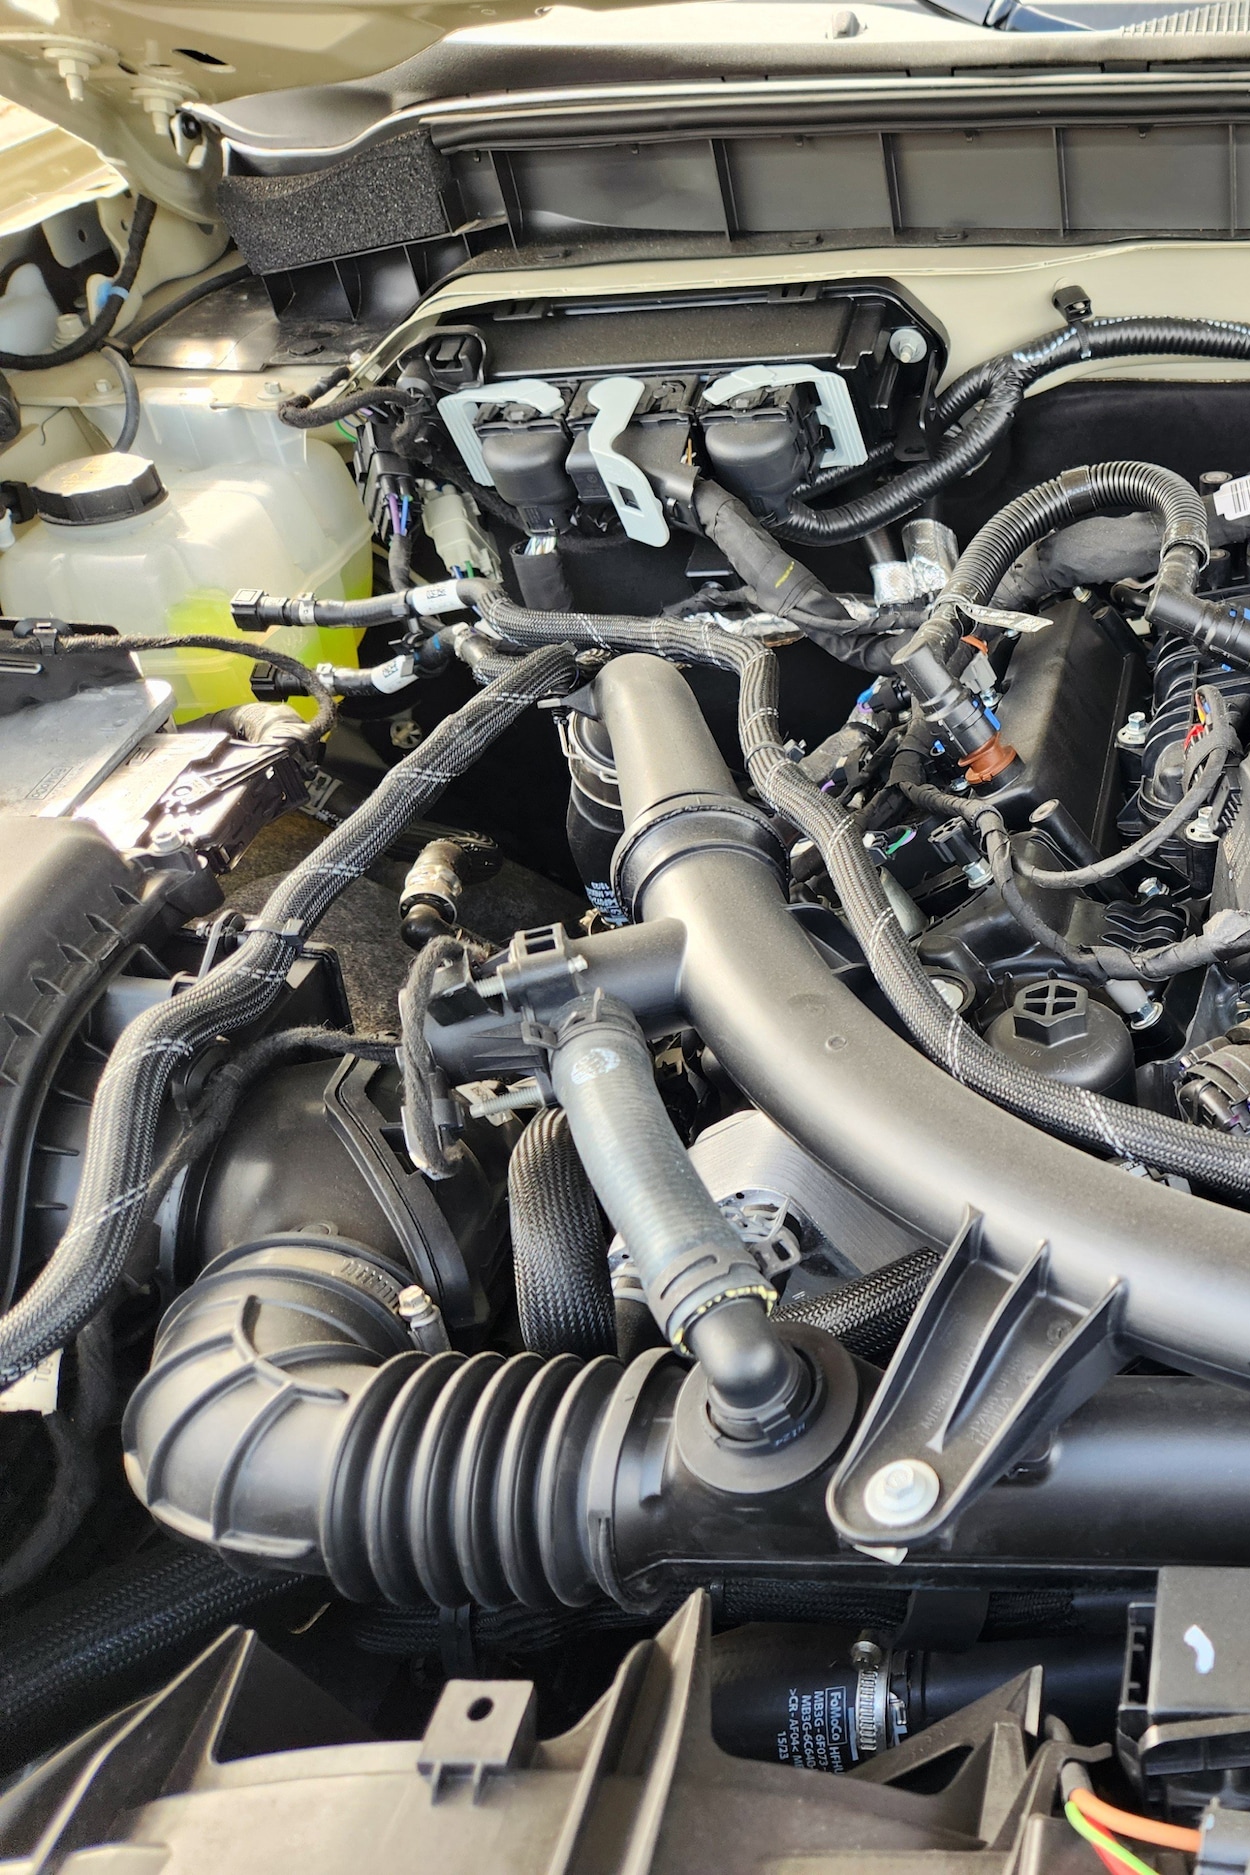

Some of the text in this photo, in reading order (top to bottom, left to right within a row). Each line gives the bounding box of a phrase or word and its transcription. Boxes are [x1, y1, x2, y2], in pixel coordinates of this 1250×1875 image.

[777, 1731, 789, 1760] 15/23
[801, 1695, 816, 1770] MB3G-6C640-
[813, 1691, 829, 1772] MB3G-6F073-
[829, 1692, 845, 1774] FoMoCo HFHU
